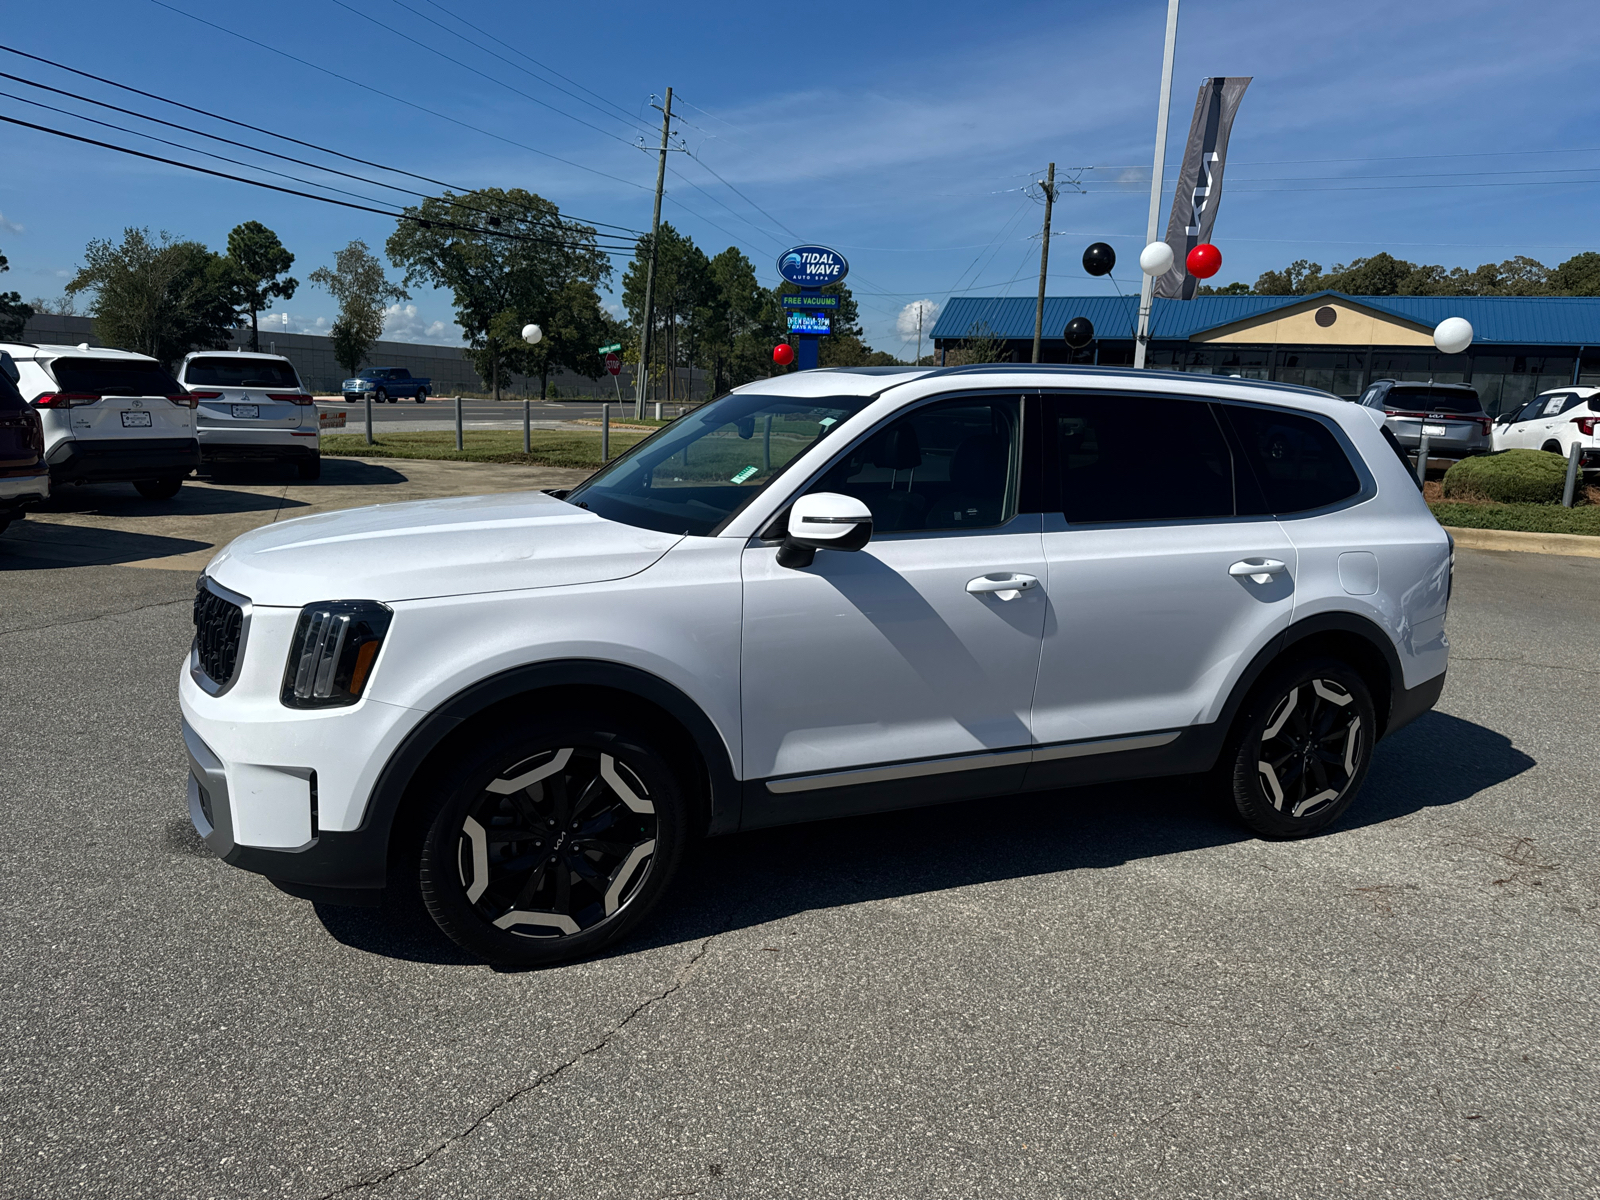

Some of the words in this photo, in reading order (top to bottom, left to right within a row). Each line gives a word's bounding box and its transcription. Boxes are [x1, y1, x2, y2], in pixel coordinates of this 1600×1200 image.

[802, 253, 834, 264] TIDAL
[807, 264, 840, 275] WAVE
[803, 297, 836, 305] VACUUMS
[787, 317, 802, 325] OPEN
[607, 360, 619, 369] STOP
